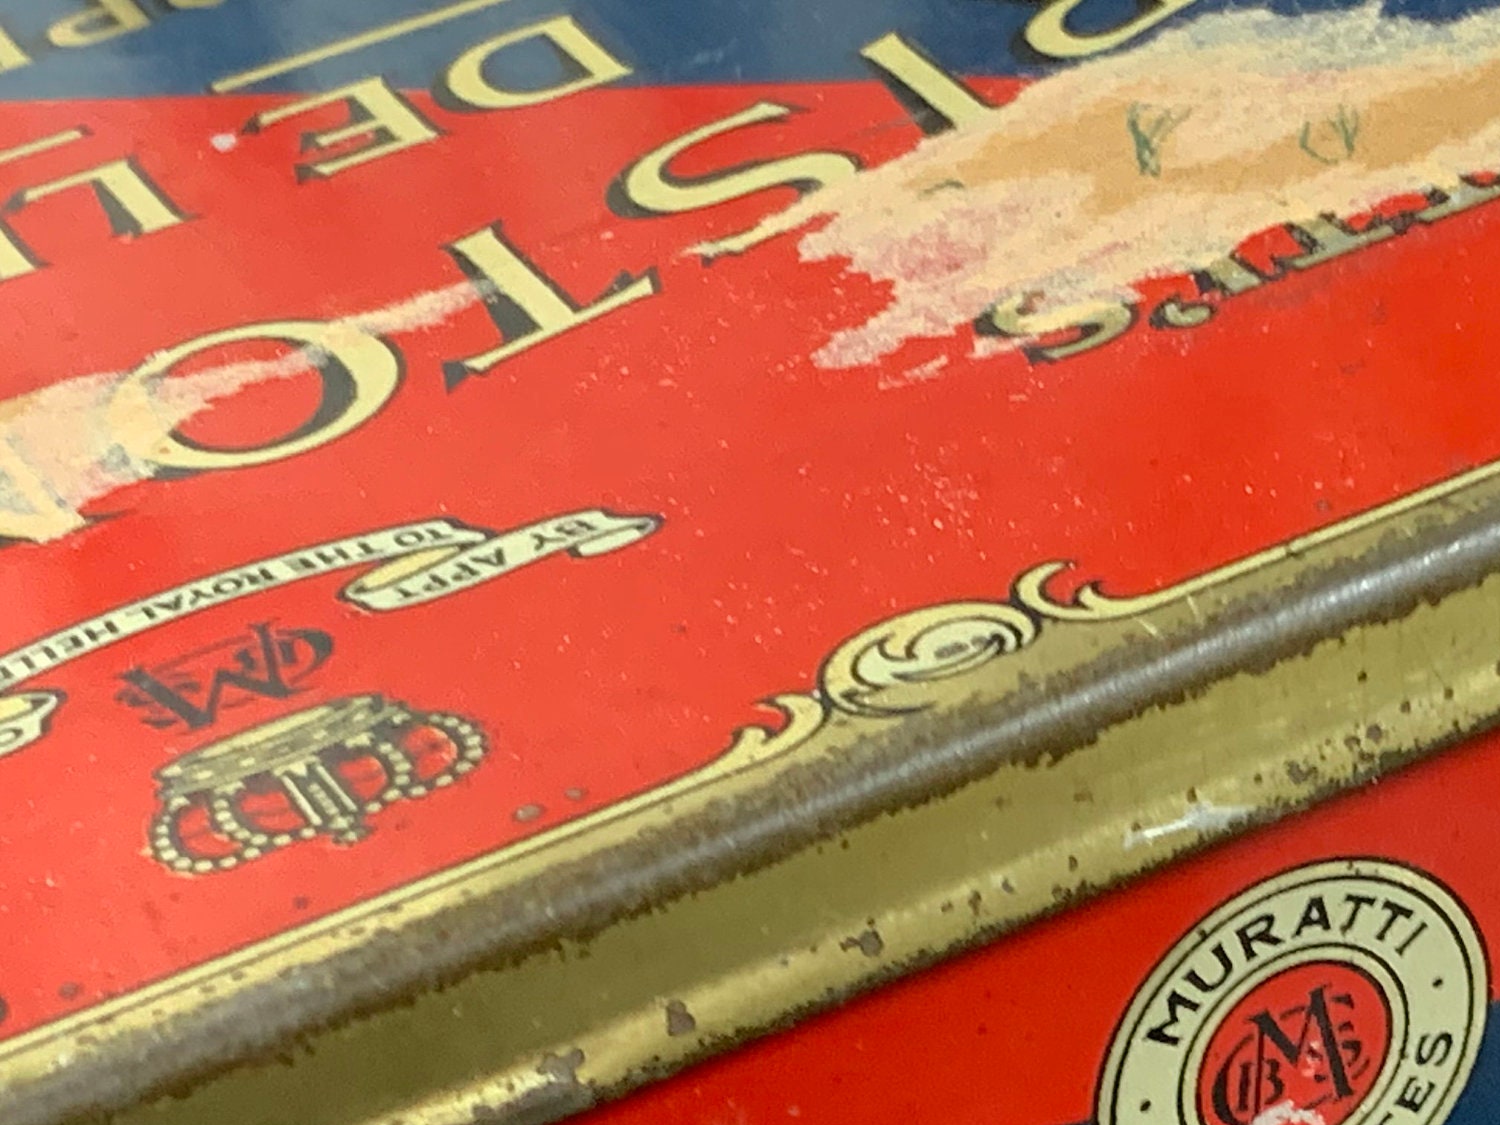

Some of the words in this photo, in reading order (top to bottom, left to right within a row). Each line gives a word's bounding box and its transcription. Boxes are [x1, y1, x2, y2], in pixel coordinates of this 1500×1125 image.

[240, 14, 634, 185] DE
[288, 540, 378, 572] THE
[392, 526, 451, 548] TO
[529, 517, 599, 551] BY
[126, 566, 275, 620] ROYAL
[395, 546, 507, 600] APPT
[1146, 893, 1429, 1048] MURATTI
